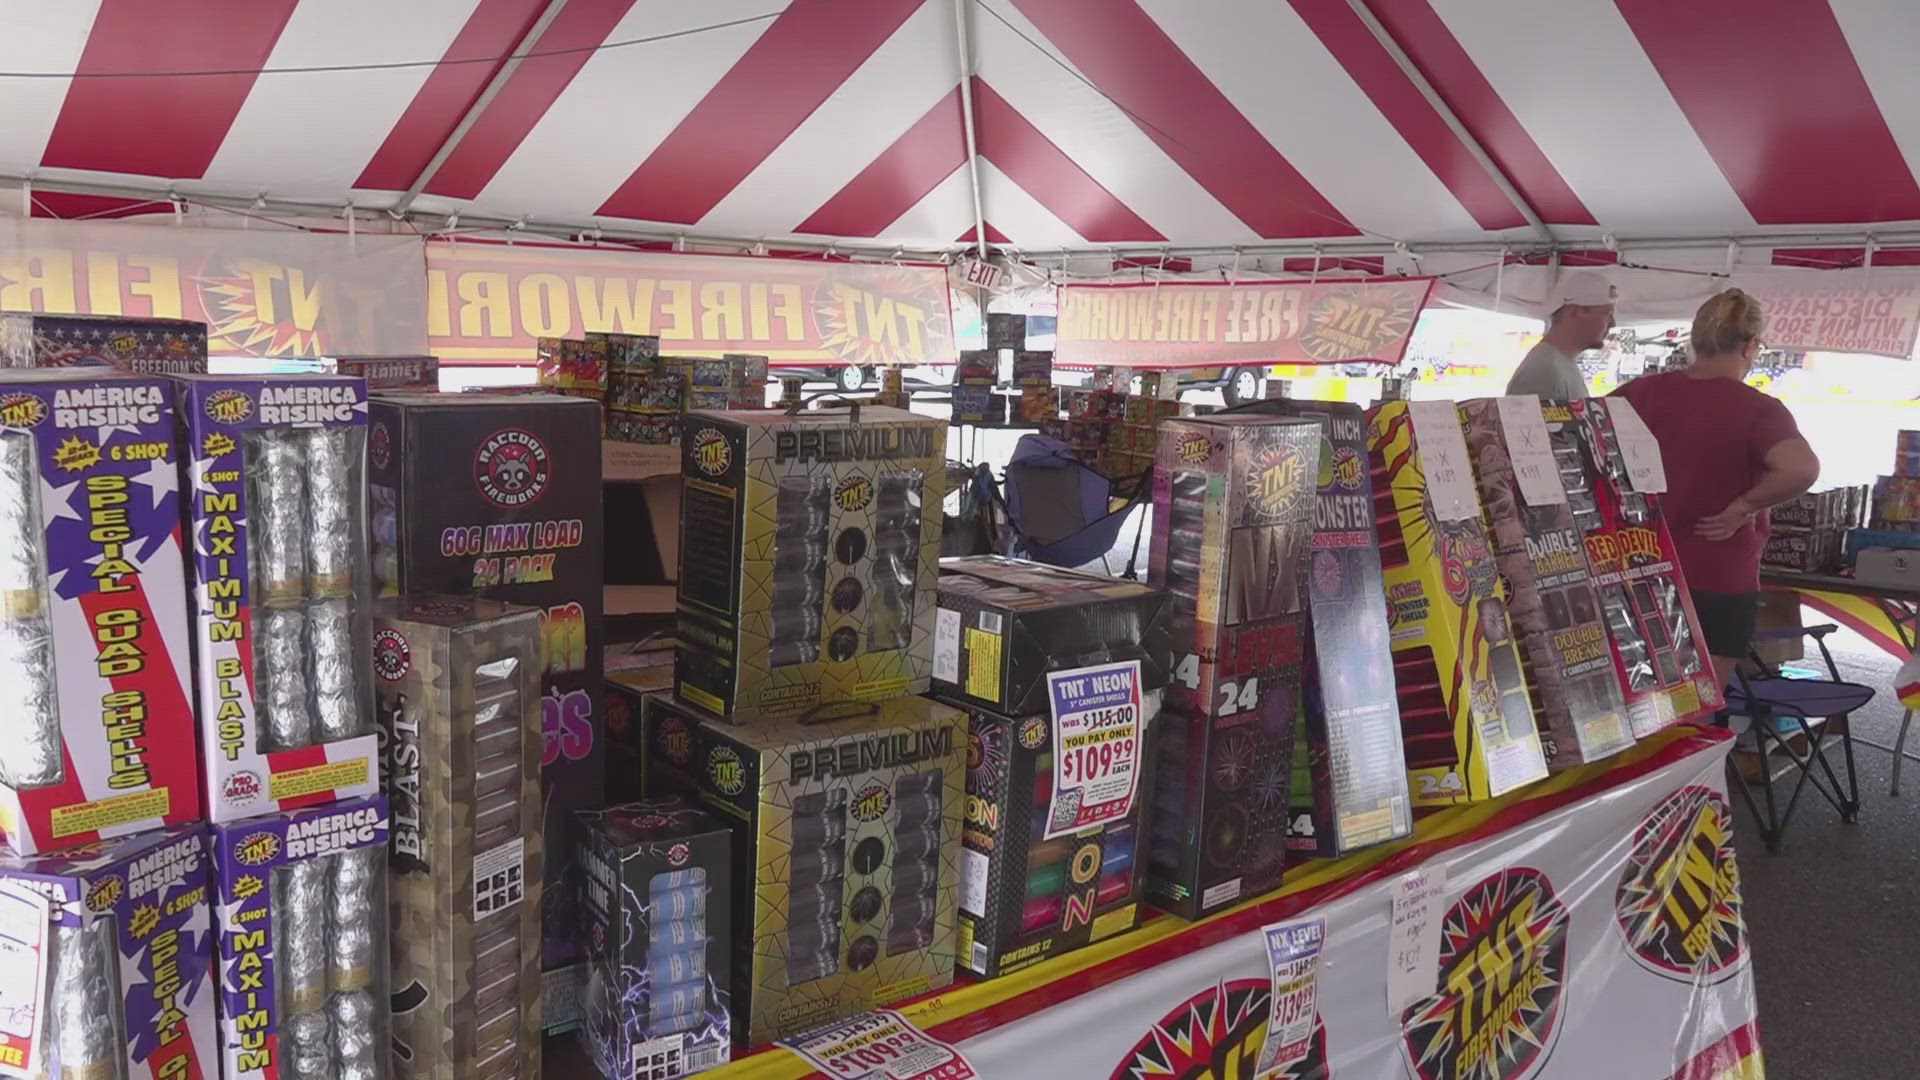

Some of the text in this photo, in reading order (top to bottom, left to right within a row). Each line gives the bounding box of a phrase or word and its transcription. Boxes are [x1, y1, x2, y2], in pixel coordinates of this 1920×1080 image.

[967, 261, 998, 287] EXIT
[363, 362, 421, 383] FLAMES
[53, 386, 165, 408] AMERICA
[213, 398, 247, 419] TNT
[259, 386, 358, 406] AMERICA
[1, 401, 36, 421] TNT
[55, 405, 160, 428] RISING
[259, 403, 354, 424] RISING
[1332, 419, 1361, 441] INCH
[110, 443, 169, 461] 6 SHOT
[478, 431, 546, 463] RACCOON
[700, 442, 726, 462] TNT
[775, 427, 934, 463] PREMIUM
[1183, 440, 1211, 456] TNT
[202, 471, 240, 482] 6 SHOT
[1262, 456, 1298, 495] TNT
[1338, 459, 1360, 477] TNT
[478, 472, 547, 505] FIREWORKS
[841, 483, 867, 505] TNT
[1315, 495, 1371, 530] ONSTER
[87, 475, 142, 593] SPECIAL
[441, 519, 583, 557] 60G MAX LOAD
[1525, 529, 1577, 561] DOUBLE
[1584, 527, 1662, 564] RED DEVIL
[203, 493, 246, 642] MAXIMUM
[472, 554, 556, 588] 24 PACK
[1534, 552, 1582, 576] BARREL
[94, 607, 148, 678] QUAD
[1553, 624, 1601, 650] DOUBLE
[1563, 643, 1601, 666] BREAK
[761, 685, 806, 702] CONTAINS
[1093, 671, 1131, 694] NEON
[215, 658, 246, 761] BLAST
[1218, 677, 1259, 717] 24
[1062, 705, 1133, 729] was $115.00
[101, 690, 152, 790] SHELLS
[1066, 727, 1132, 748] YOU PAY ONLY
[789, 726, 954, 786] PREMIUM
[232, 775, 253, 788] PRO
[715, 763, 737, 780] TNT
[1112, 764, 1131, 775] EACH
[1415, 771, 1464, 794] 24
[225, 783, 259, 798] GRADE
[393, 710, 422, 860] BLAST
[857, 794, 886, 817] TNT
[286, 807, 379, 842] AMERICA
[244, 838, 272, 863] TNT
[286, 827, 377, 859] RISING
[128, 835, 201, 882] AMERICA
[128, 857, 200, 900] RISING
[92, 880, 118, 906] TNT
[166, 886, 206, 917] 6 SHOT
[231, 907, 267, 925] 6 SHOT
[1270, 925, 1322, 950] NX LEVEL
[999, 941, 1041, 967] CONTAINS
[1041, 937, 1053, 951] 12
[1447, 890, 1540, 1043] TNT
[150, 929, 188, 1046] SPECIAL
[233, 929, 270, 1073] MAXIMUM
[778, 999, 827, 1022] CONTAINS
[1456, 961, 1545, 1080] FIREWORKS
[821, 1025, 900, 1059] YOU PAY ONLY
